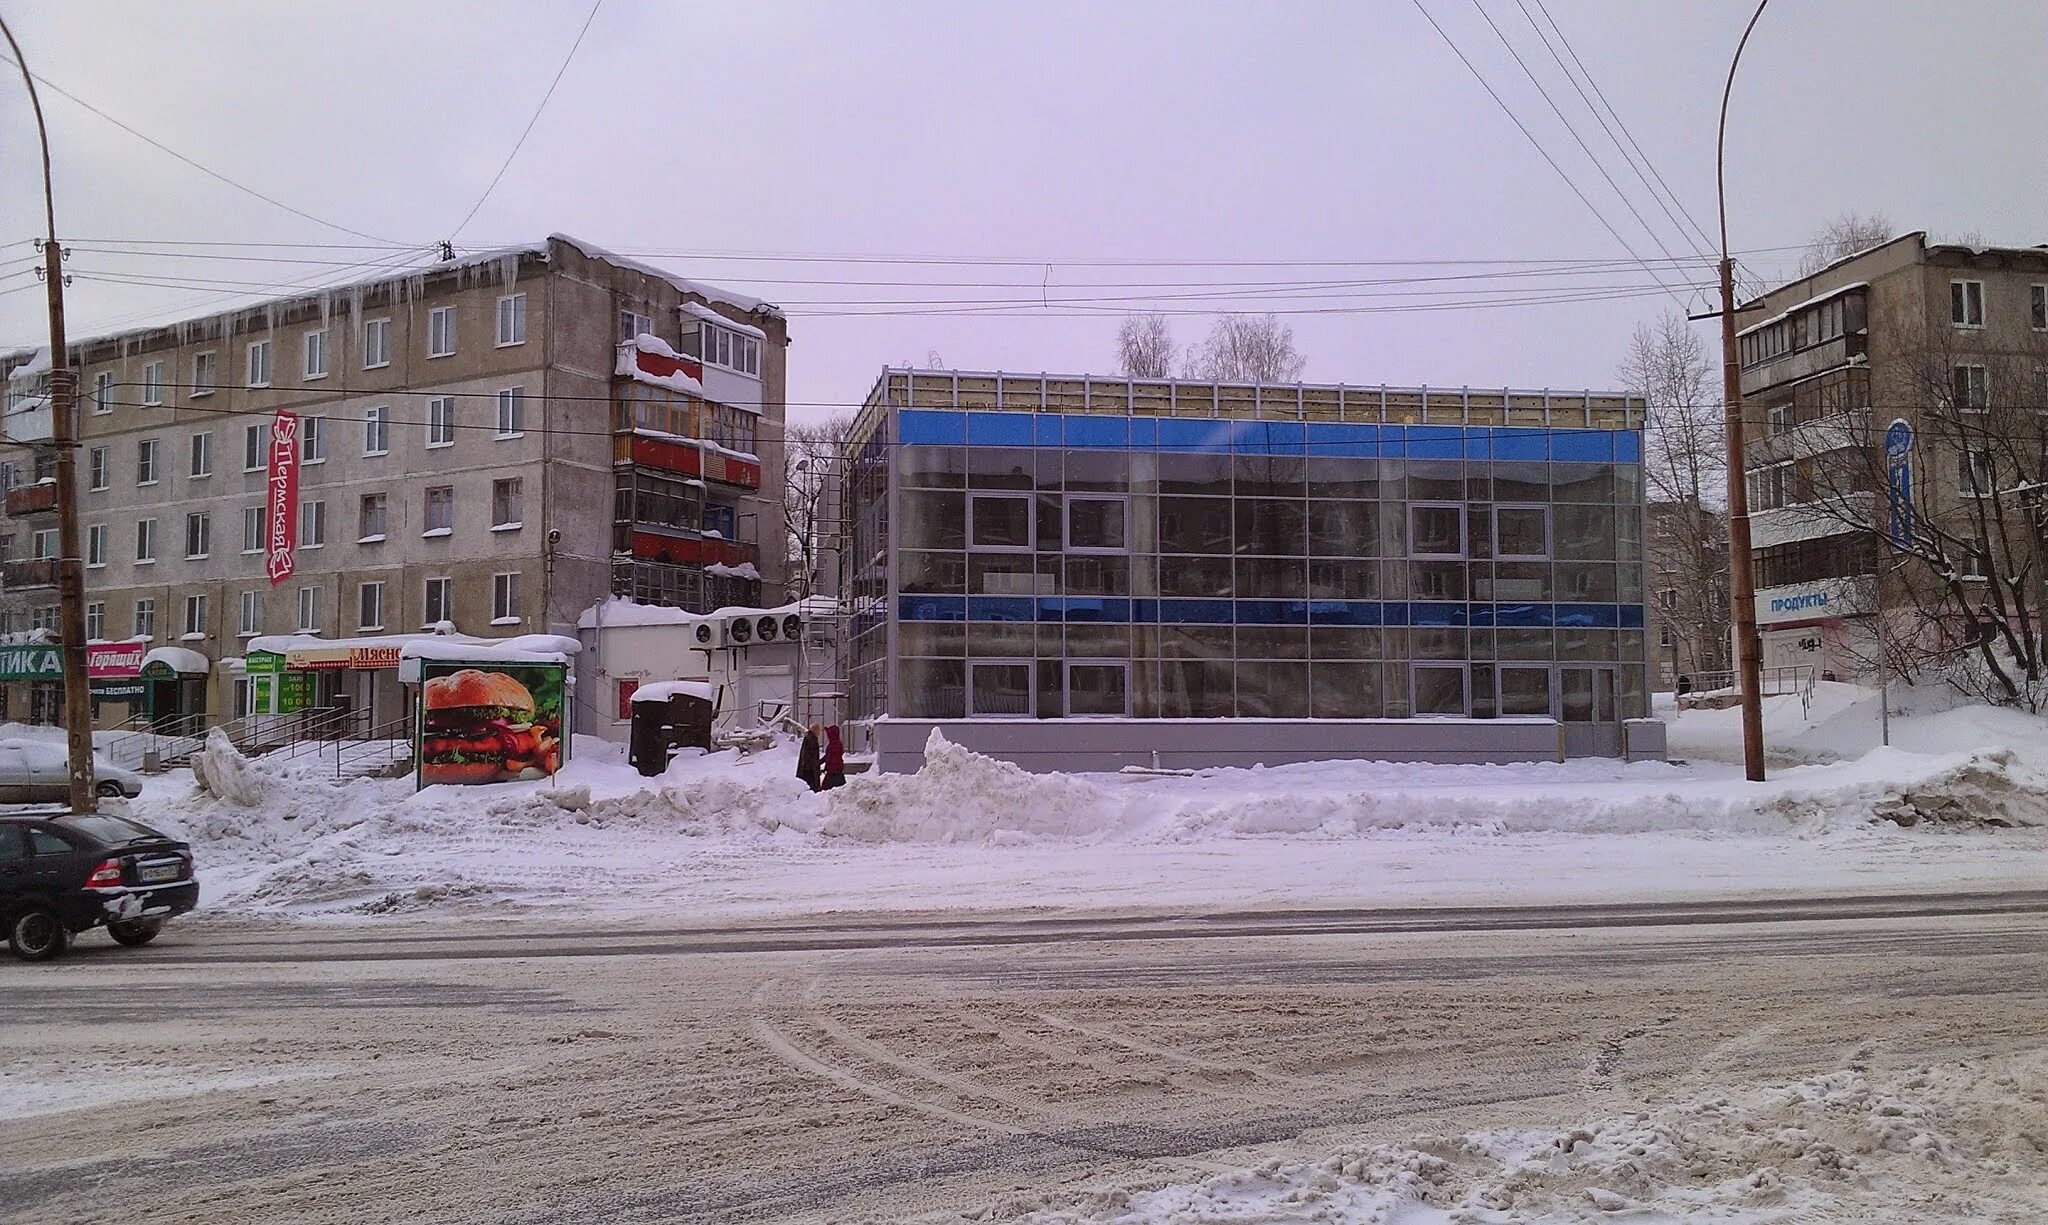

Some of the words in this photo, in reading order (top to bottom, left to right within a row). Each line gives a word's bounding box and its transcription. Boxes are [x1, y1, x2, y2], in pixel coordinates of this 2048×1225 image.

[270, 446, 293, 547] Пермская
[1771, 592, 1828, 612] ПРОДУКТЫ
[89, 651, 142, 670] Горящих
[106, 686, 145, 695] БЕСПЛАТНО
